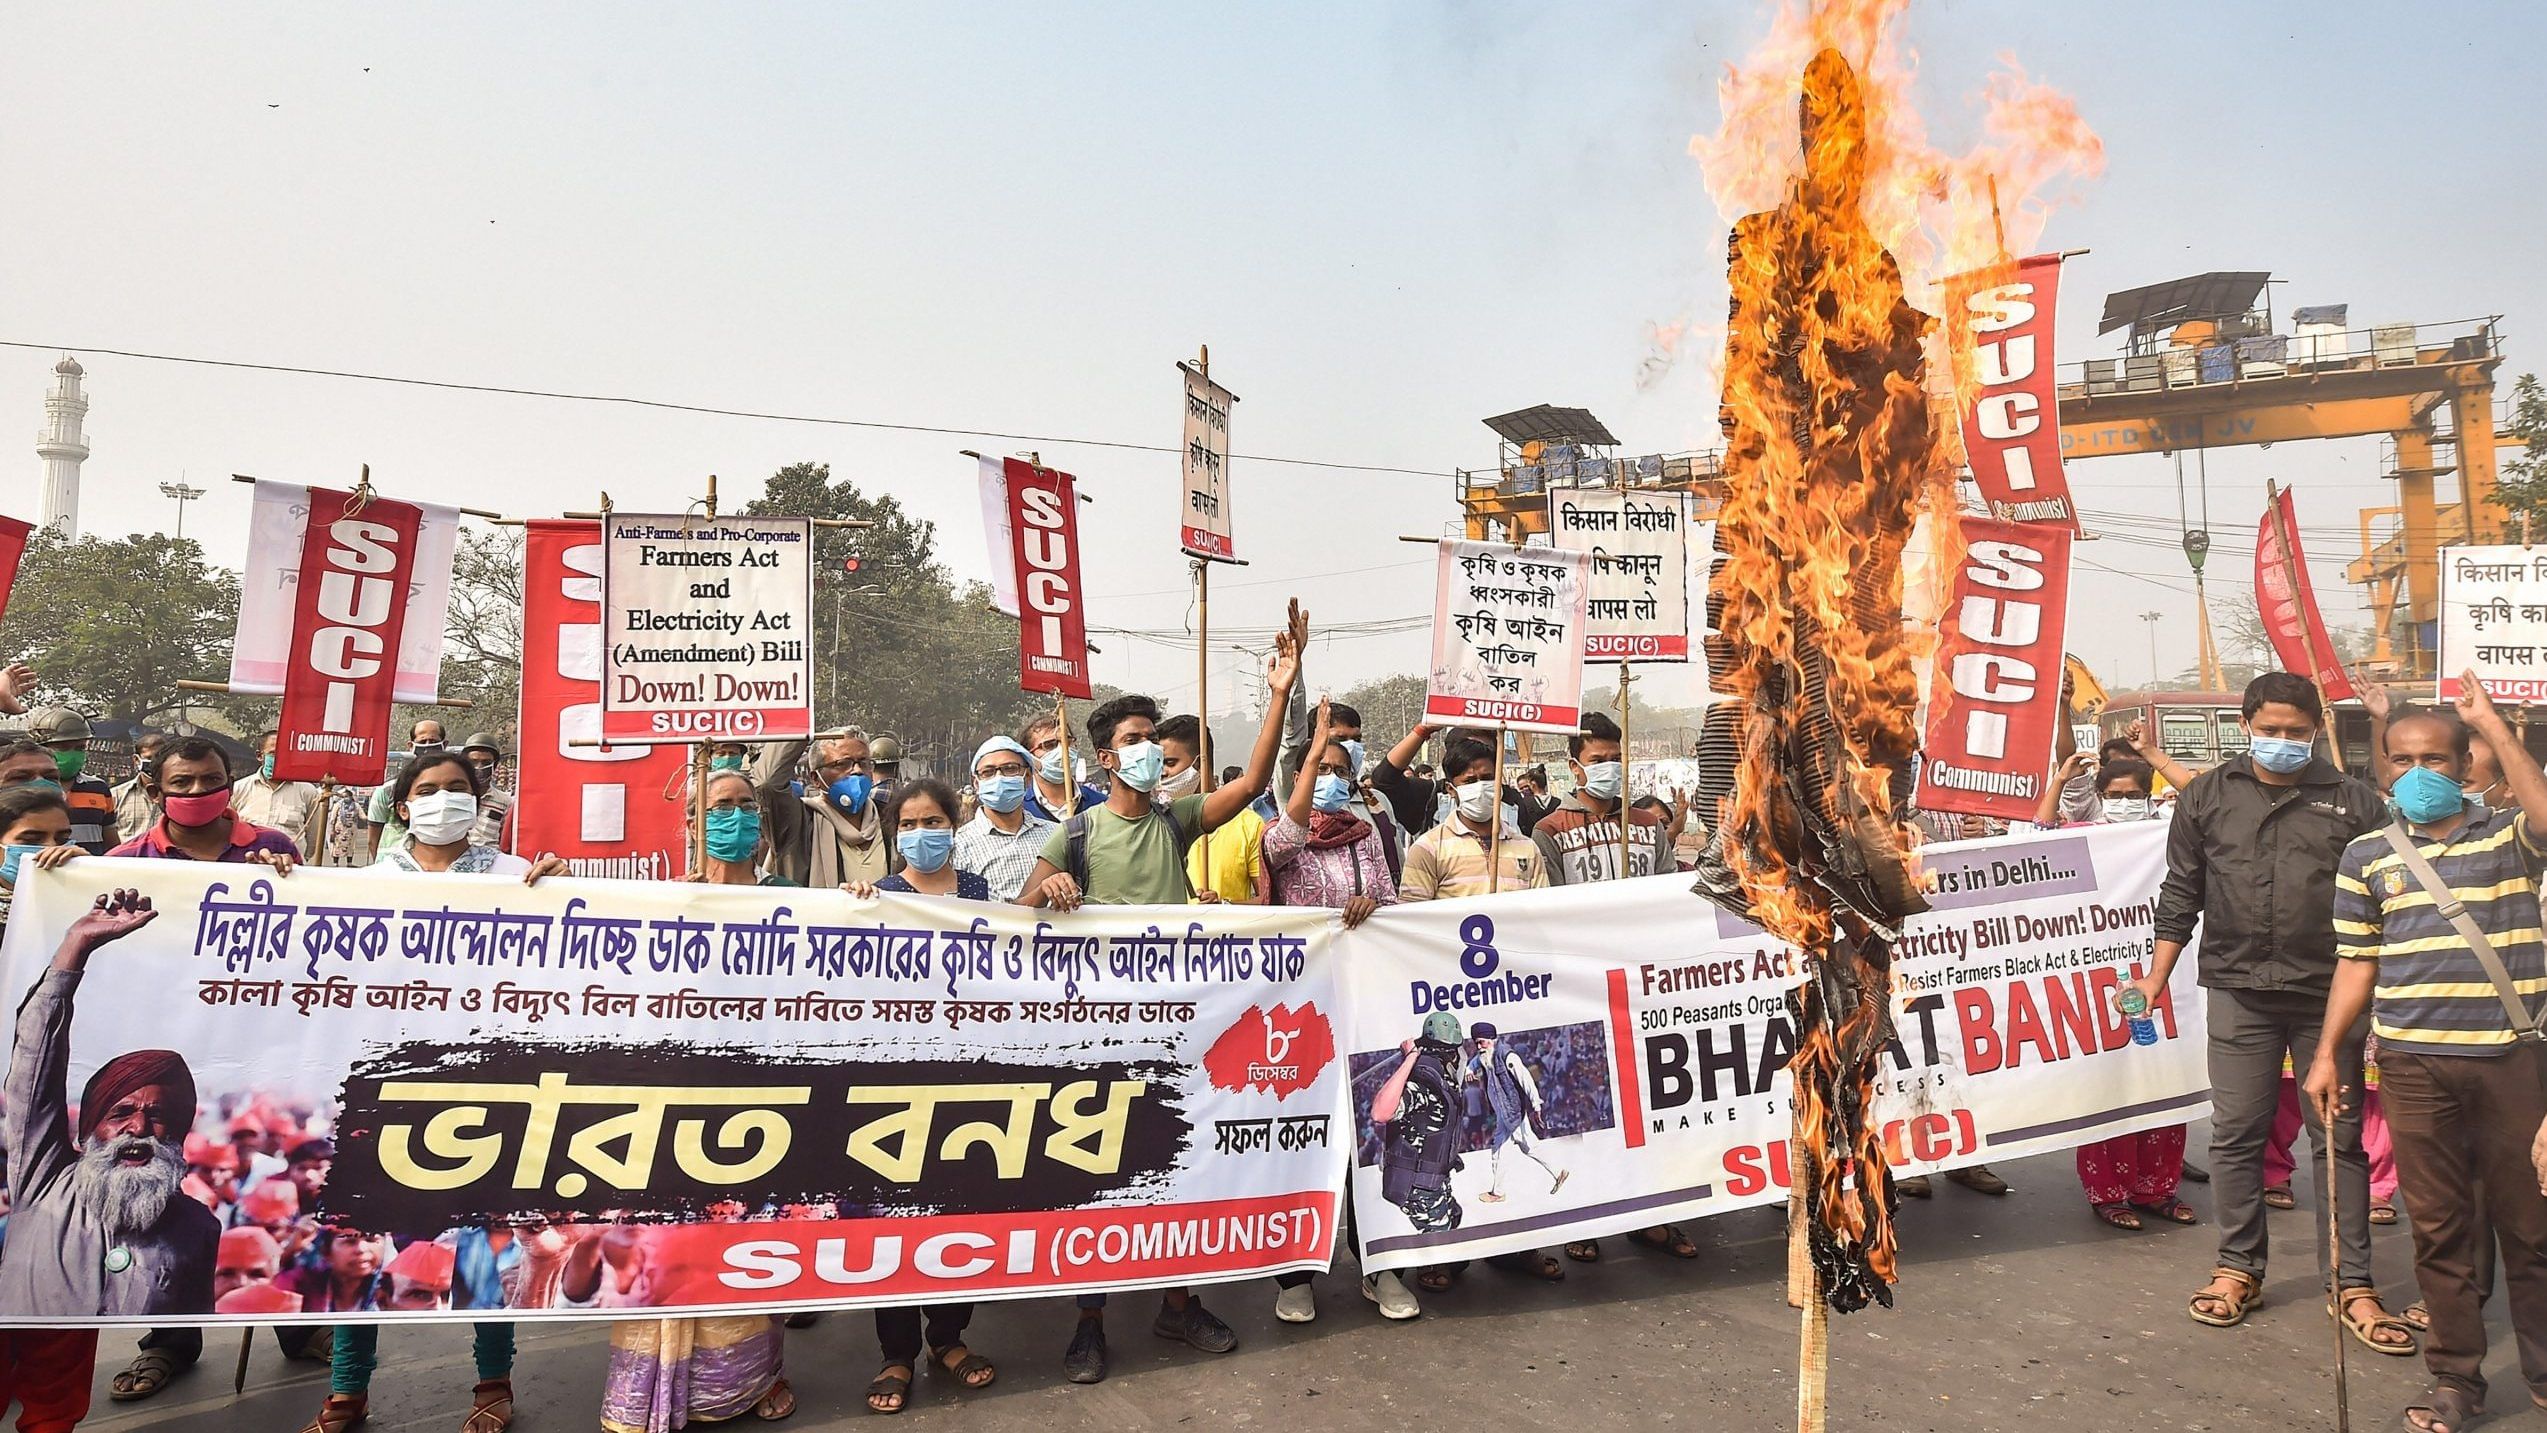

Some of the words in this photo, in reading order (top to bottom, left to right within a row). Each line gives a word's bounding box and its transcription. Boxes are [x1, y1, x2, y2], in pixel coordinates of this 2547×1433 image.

[1966, 283, 2040, 491] SUCI
[2217, 416, 2256, 437] JV
[1560, 502, 1618, 532] किसान
[1624, 502, 1676, 533] विरोधी
[1991, 494, 2071, 522] (Cmmunist)
[614, 525, 694, 540] Anti-Farmes
[696, 526, 718, 541] and
[721, 527, 801, 543] Pro-Corporate
[639, 545, 732, 567] Farmers
[738, 547, 779, 568] Act
[1021, 487, 1071, 657] SUCI
[1460, 552, 1498, 582] কৃষি
[1501, 560, 1516, 577] ও
[1519, 562, 1567, 586] কৃষক
[1614, 555, 1662, 586] कानून
[2455, 557, 2527, 583] किसान
[690, 578, 730, 599] and
[1469, 584, 1556, 610] ধ্বংসকারী
[1632, 590, 1657, 620] लो
[310, 519, 399, 734] SUCI
[626, 610, 745, 635] Electricity
[750, 611, 791, 631] Act
[1453, 609, 1498, 643] কৃষি
[1505, 615, 1564, 643] আইন
[2467, 597, 2514, 631] कृषि
[613, 643, 756, 667] (Amendment)
[761, 641, 803, 662] Bill
[1476, 643, 1538, 668] বাতিল
[1586, 637, 1659, 656] SUCI(C)
[1953, 540, 2045, 759] SUCI
[2475, 645, 2536, 665] वापस
[618, 674, 705, 704] Down!
[714, 672, 799, 702] Down!
[1487, 674, 1522, 694] কর
[651, 711, 765, 737] SUCI(C)
[1464, 700, 1543, 721] SUCI(C)
[1927, 759, 2040, 799] (Communist)
[1963, 864, 1988, 890] in
[194, 879, 297, 974] দিল্লীর
[303, 904, 394, 980] কৃষক
[400, 905, 553, 967] আন্দোলন
[558, 898, 642, 977] দিচ্ছে
[648, 916, 715, 975] ডাক
[721, 907, 799, 977] মোদি
[805, 922, 934, 982] সরকারের
[941, 917, 997, 999] কৃষি
[1003, 935, 1023, 981] ও
[1032, 922, 1100, 1000] বিদ্যুৎ
[1109, 926, 1178, 984] আইন
[1183, 922, 1253, 983] নিপাত
[1260, 930, 1306, 984] যাক
[1460, 914, 1499, 979] 8
[1640, 959, 1746, 996] Farmers
[1752, 948, 1796, 981] Act
[1889, 922, 1967, 962] ctricity
[1974, 917, 2010, 949] Bill
[2015, 906, 2085, 942] Down!
[1411, 970, 1553, 1014] December
[1640, 1008, 1668, 1030] 500
[1673, 999, 1743, 1026] Peasants
[1947, 960, 2002, 985] Farmers
[2005, 954, 2042, 976] Black
[2045, 948, 2067, 970] Act
[2070, 949, 2079, 966] &
[2082, 940, 2143, 965] Electricity
[199, 979, 283, 1007] কালা
[292, 975, 356, 1016] কৃষি
[366, 980, 451, 1012] আইন
[460, 985, 482, 1011] ও
[492, 982, 569, 1022] বিদ্যুৎ
[582, 984, 640, 1017] বিল
[647, 988, 767, 1022] বাতিলের
[773, 991, 865, 1022] দাবিতে
[872, 997, 935, 1024] সমস্ত
[943, 999, 1013, 1030] কৃষক
[1020, 993, 1130, 1024] সংগঠনের
[1137, 1000, 1195, 1023] ডাকে
[1263, 1015, 1300, 1064] ৮
[1645, 994, 1944, 1111] BHAT
[1247, 1062, 1299, 1082] ডিসেম্বর
[1653, 1107, 1737, 1135] MAKE
[1767, 1073, 1945, 1115] SUCESS
[377, 1073, 811, 1198] ভারত
[845, 1073, 1147, 1184] বনধ
[1215, 1117, 1273, 1155] সফল
[1278, 1114, 1331, 1153] করুন
[1723, 1109, 1977, 1197] SU(C)
[718, 1229, 1037, 1290] SUCI
[1049, 1208, 1322, 1277] (COMMUNIST)
